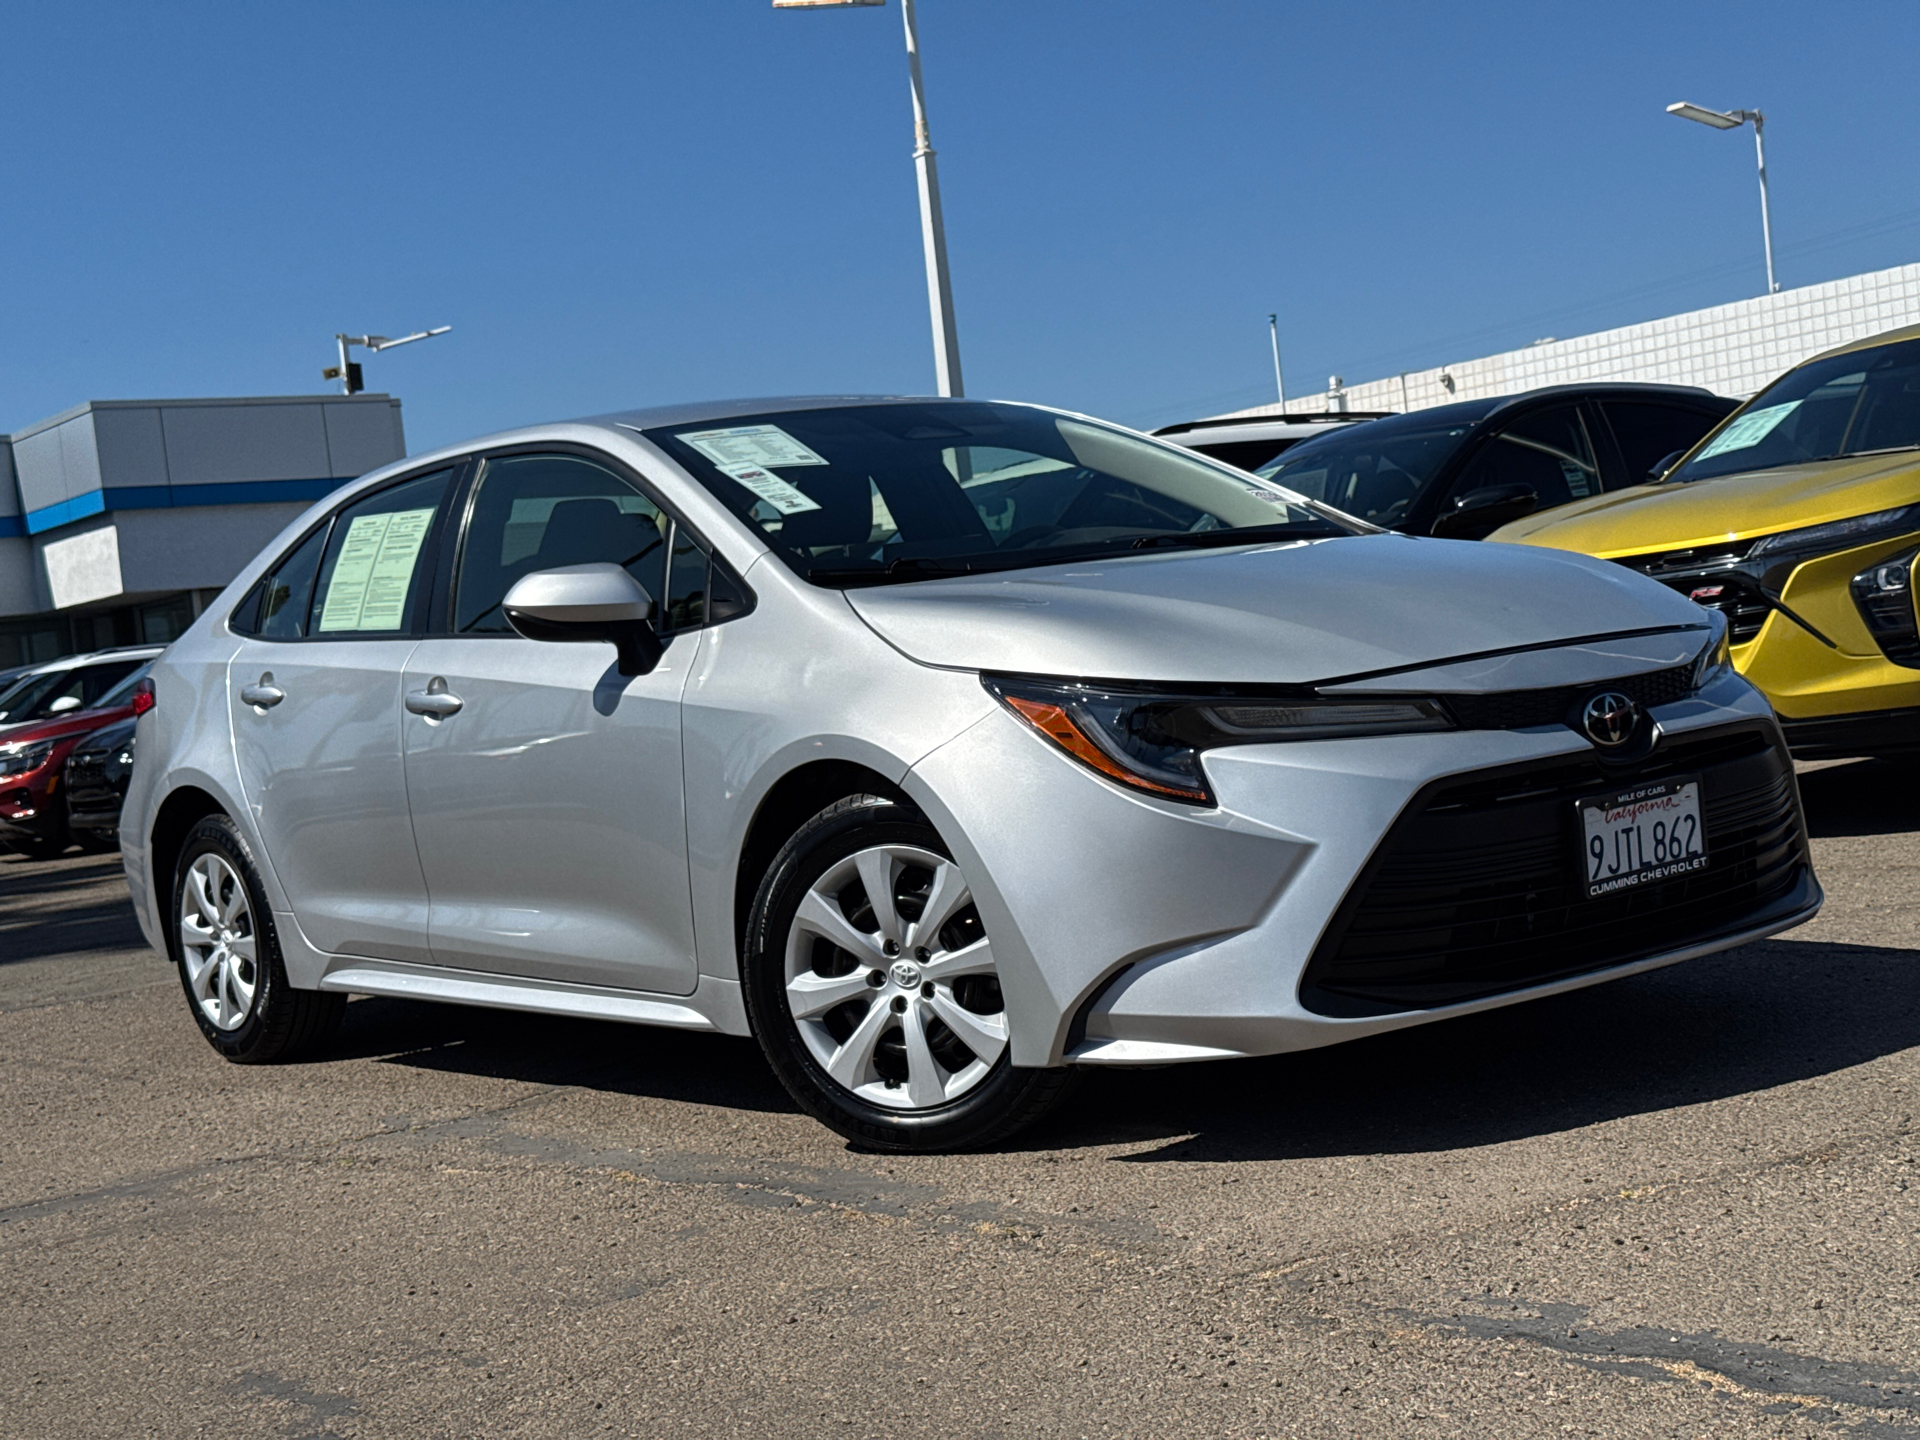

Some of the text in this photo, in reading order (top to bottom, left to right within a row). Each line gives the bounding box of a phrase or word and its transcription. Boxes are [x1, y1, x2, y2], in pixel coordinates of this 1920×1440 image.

[1604, 796, 1680, 824] California
[1617, 785, 1666, 803] MILE OF CARS
[1589, 813, 1698, 880] 9JTL862
[1589, 856, 1708, 896] CUMMING CHEVROLET
